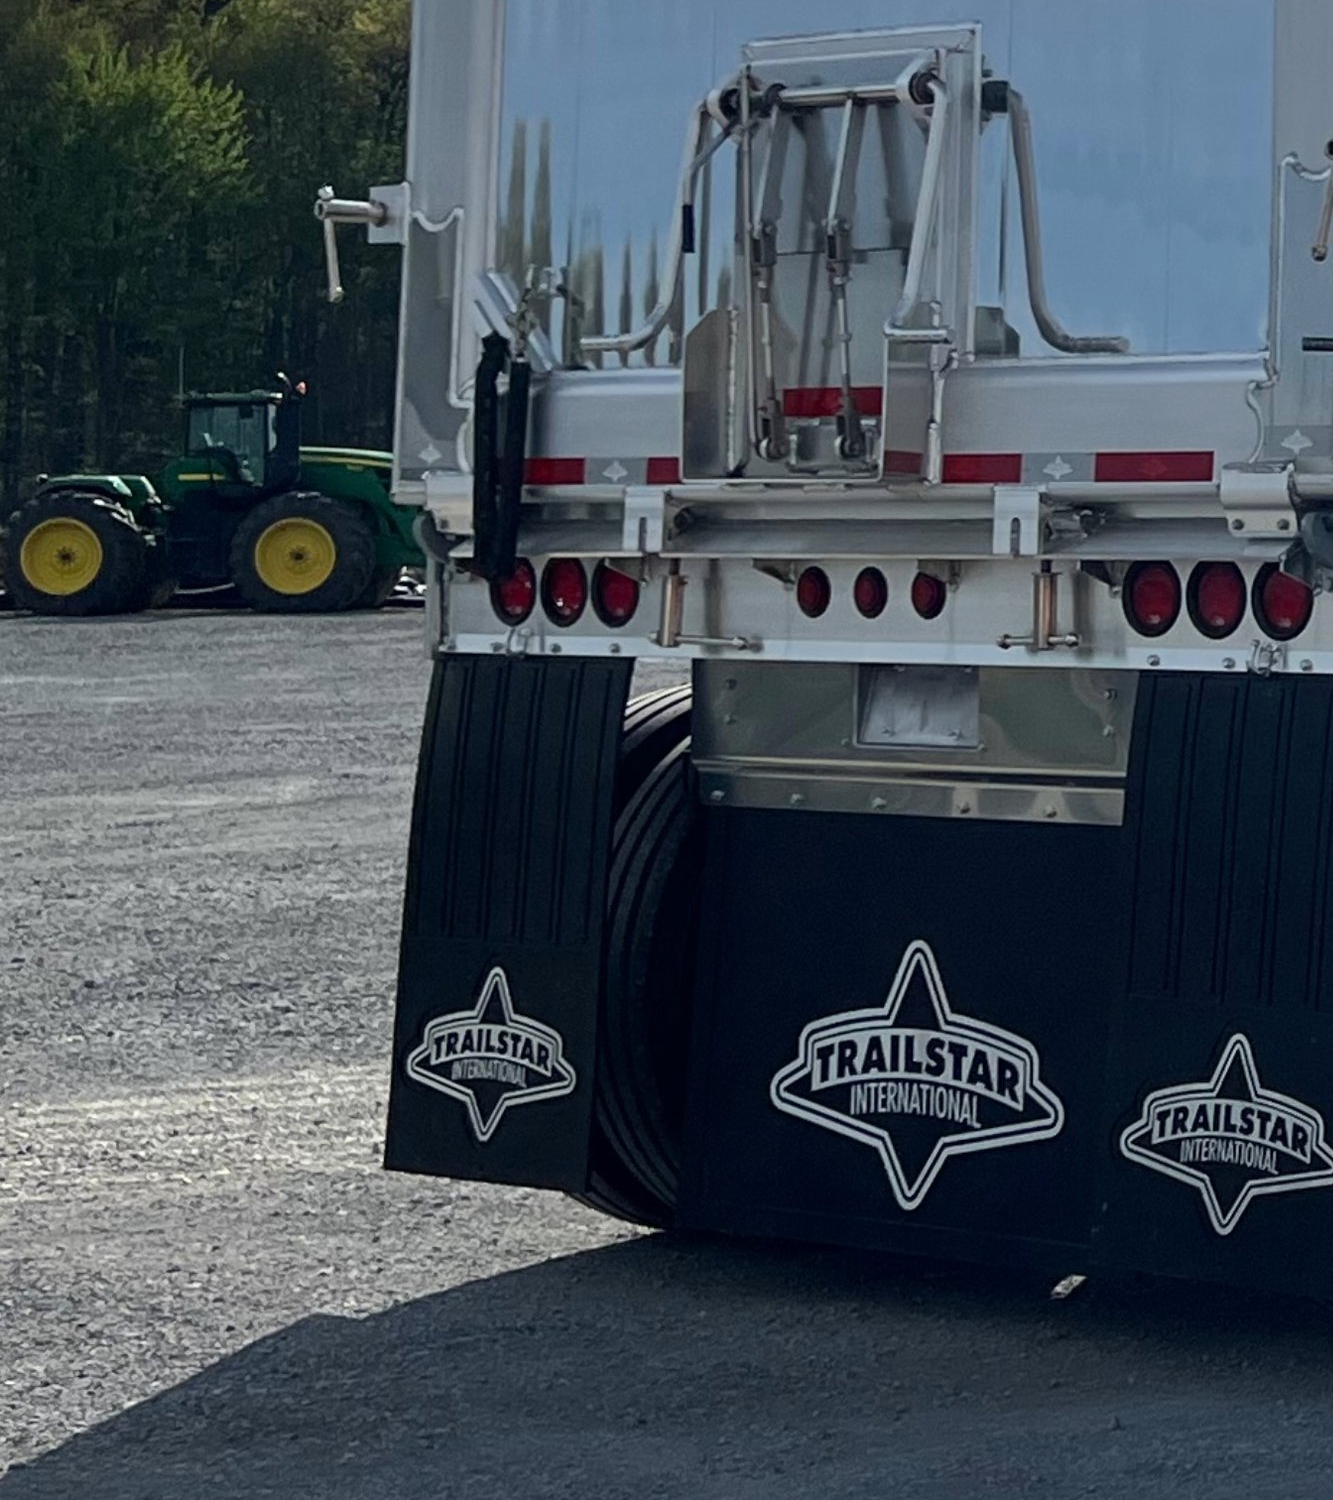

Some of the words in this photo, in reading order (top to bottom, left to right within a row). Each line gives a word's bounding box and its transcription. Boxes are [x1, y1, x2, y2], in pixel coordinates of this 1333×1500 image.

[433, 1028, 551, 1075] TRAILSTAR
[451, 1058, 528, 1088] INTERNATIONAL
[816, 1034, 1021, 1108] TRAILSTAR
[850, 1081, 982, 1129] INTERNATIONAL
[1155, 1103, 1309, 1160] TRAILSTAR
[1179, 1138, 1279, 1175] INTERNATIONAL
